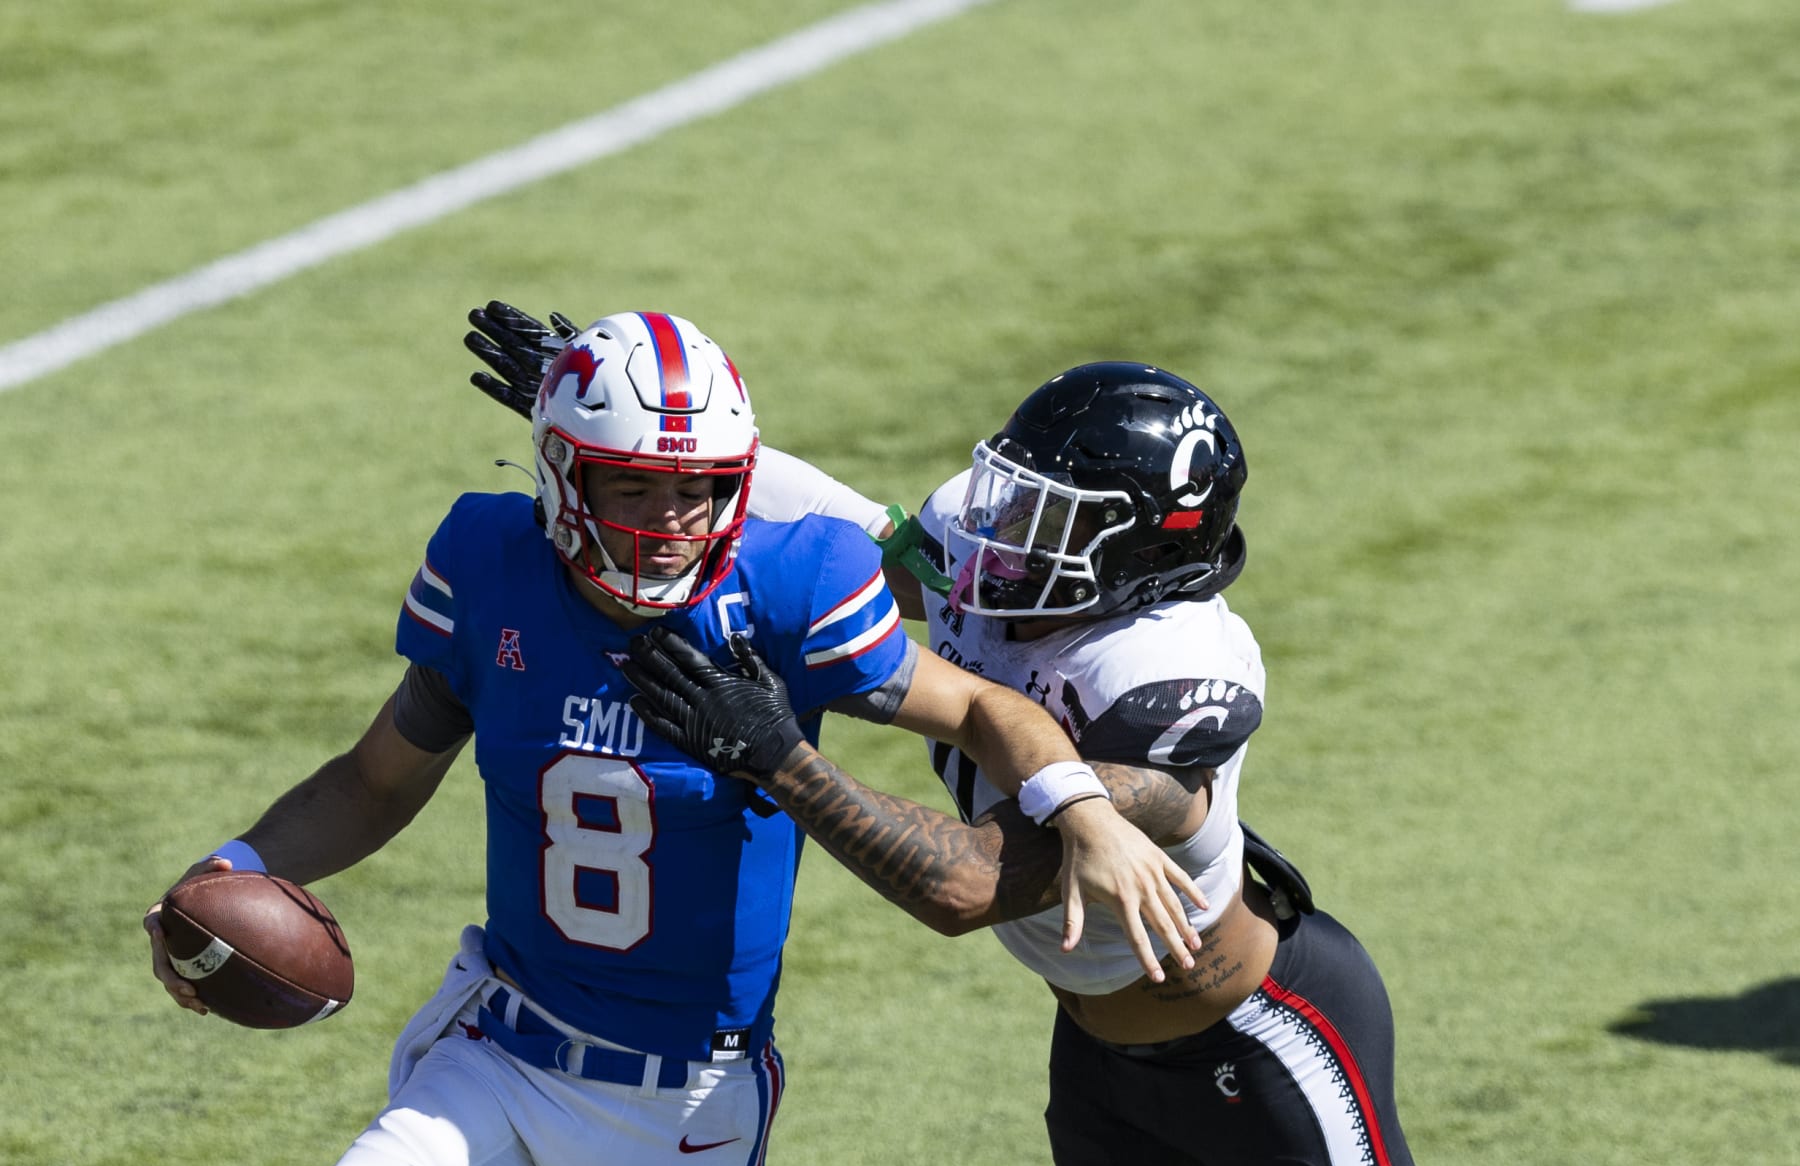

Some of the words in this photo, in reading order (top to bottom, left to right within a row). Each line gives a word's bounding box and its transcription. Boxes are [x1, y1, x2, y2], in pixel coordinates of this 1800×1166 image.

[656, 436, 698, 453] SMU
[717, 591, 755, 642] C
[558, 695, 645, 758] SMU
[537, 750, 658, 954] 8
[724, 1034, 739, 1047] M
